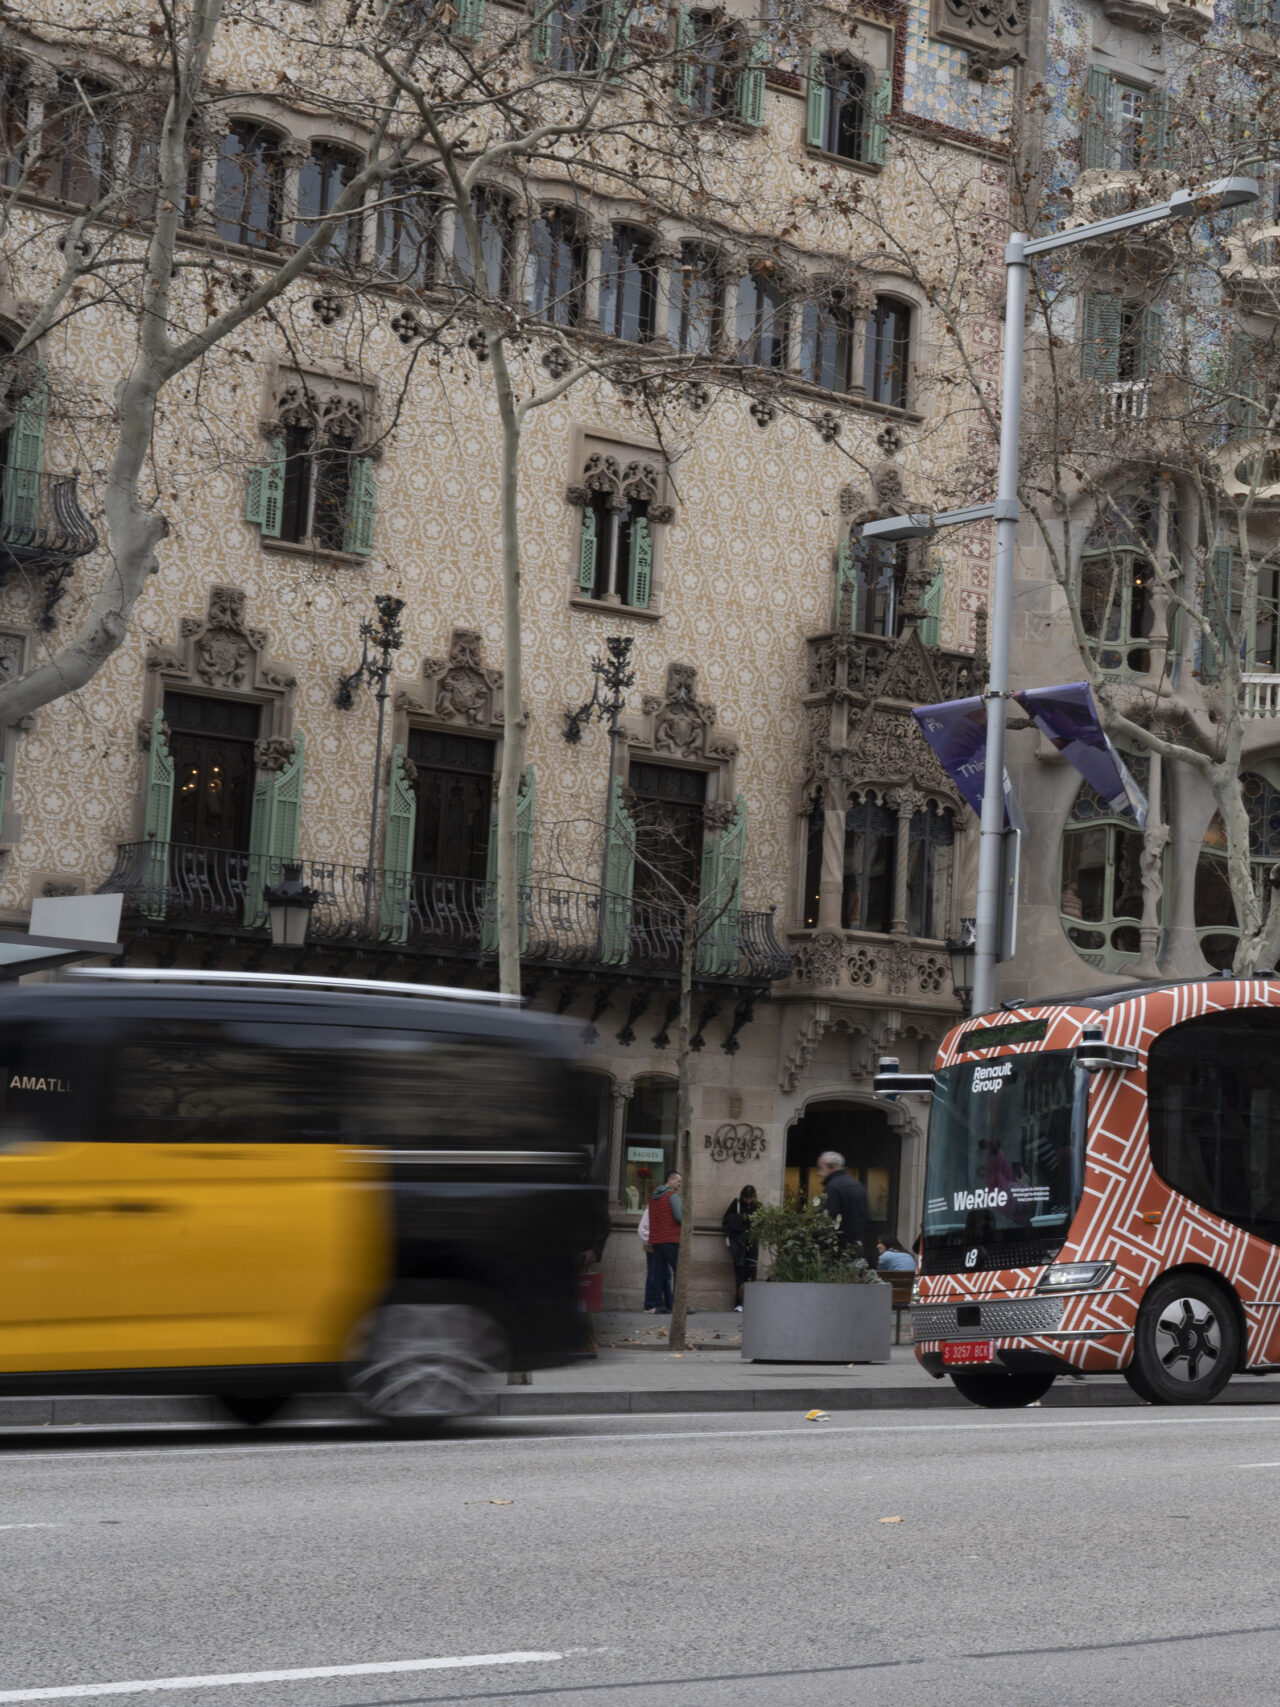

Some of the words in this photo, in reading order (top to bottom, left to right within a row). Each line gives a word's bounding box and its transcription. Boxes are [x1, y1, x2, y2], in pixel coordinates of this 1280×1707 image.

[973, 1062, 1013, 1080] Renault
[972, 1078, 1003, 1093] Group
[953, 1187, 1008, 1212] WeRide
[944, 1346, 950, 1359] S
[952, 1345, 972, 1359] 3257
